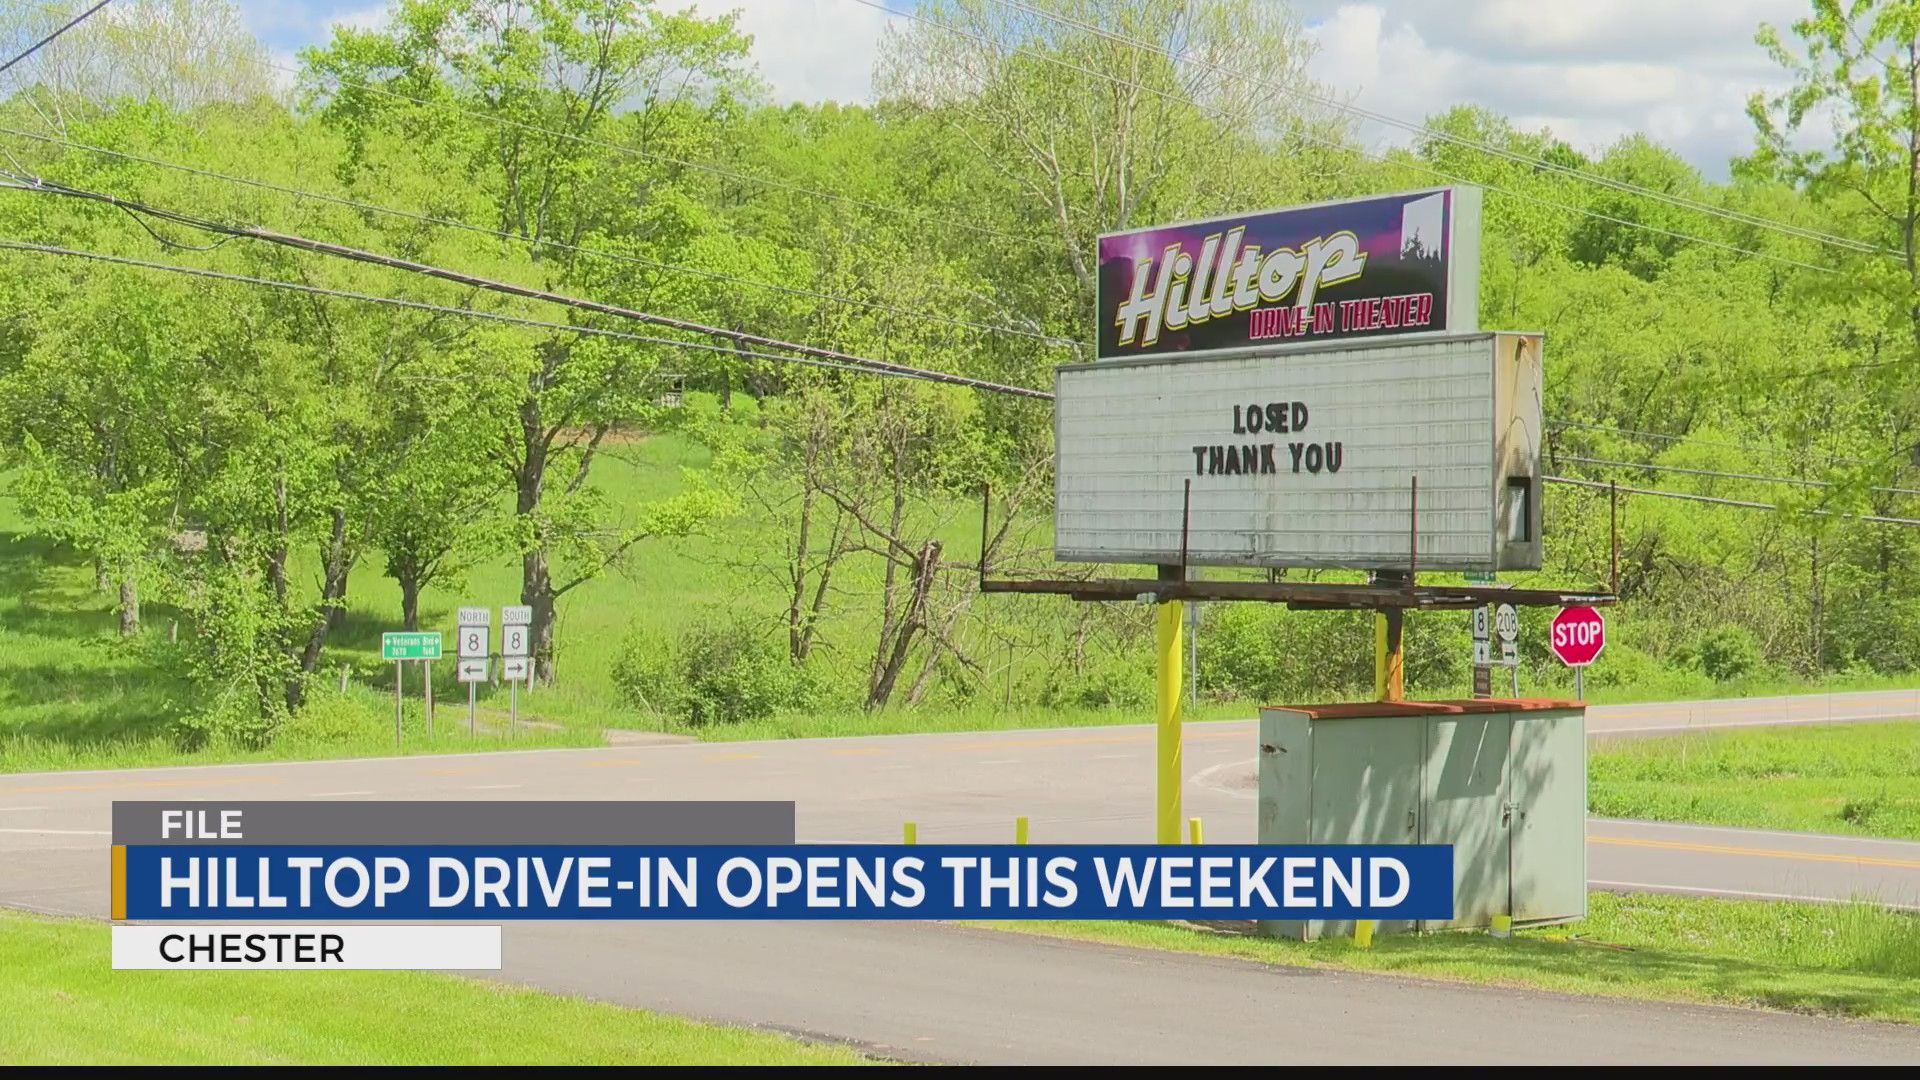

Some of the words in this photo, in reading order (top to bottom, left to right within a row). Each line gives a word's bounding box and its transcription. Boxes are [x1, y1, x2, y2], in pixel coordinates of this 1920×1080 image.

[1115, 225, 1368, 347] Hilltop
[1250, 302, 1335, 340] DRIVE-IN
[1340, 293, 1432, 332] THEATER
[1233, 401, 1309, 434] LOSED
[1192, 443, 1276, 476] THANK
[1288, 441, 1343, 474] YOU
[459, 610, 489, 623] NORTH
[504, 609, 530, 621] SOUTH
[1477, 611, 1486, 633] 8
[1497, 611, 1517, 634] 208
[468, 633, 480, 652] 8
[511, 631, 521, 650] 8
[1555, 620, 1601, 647] STOP
